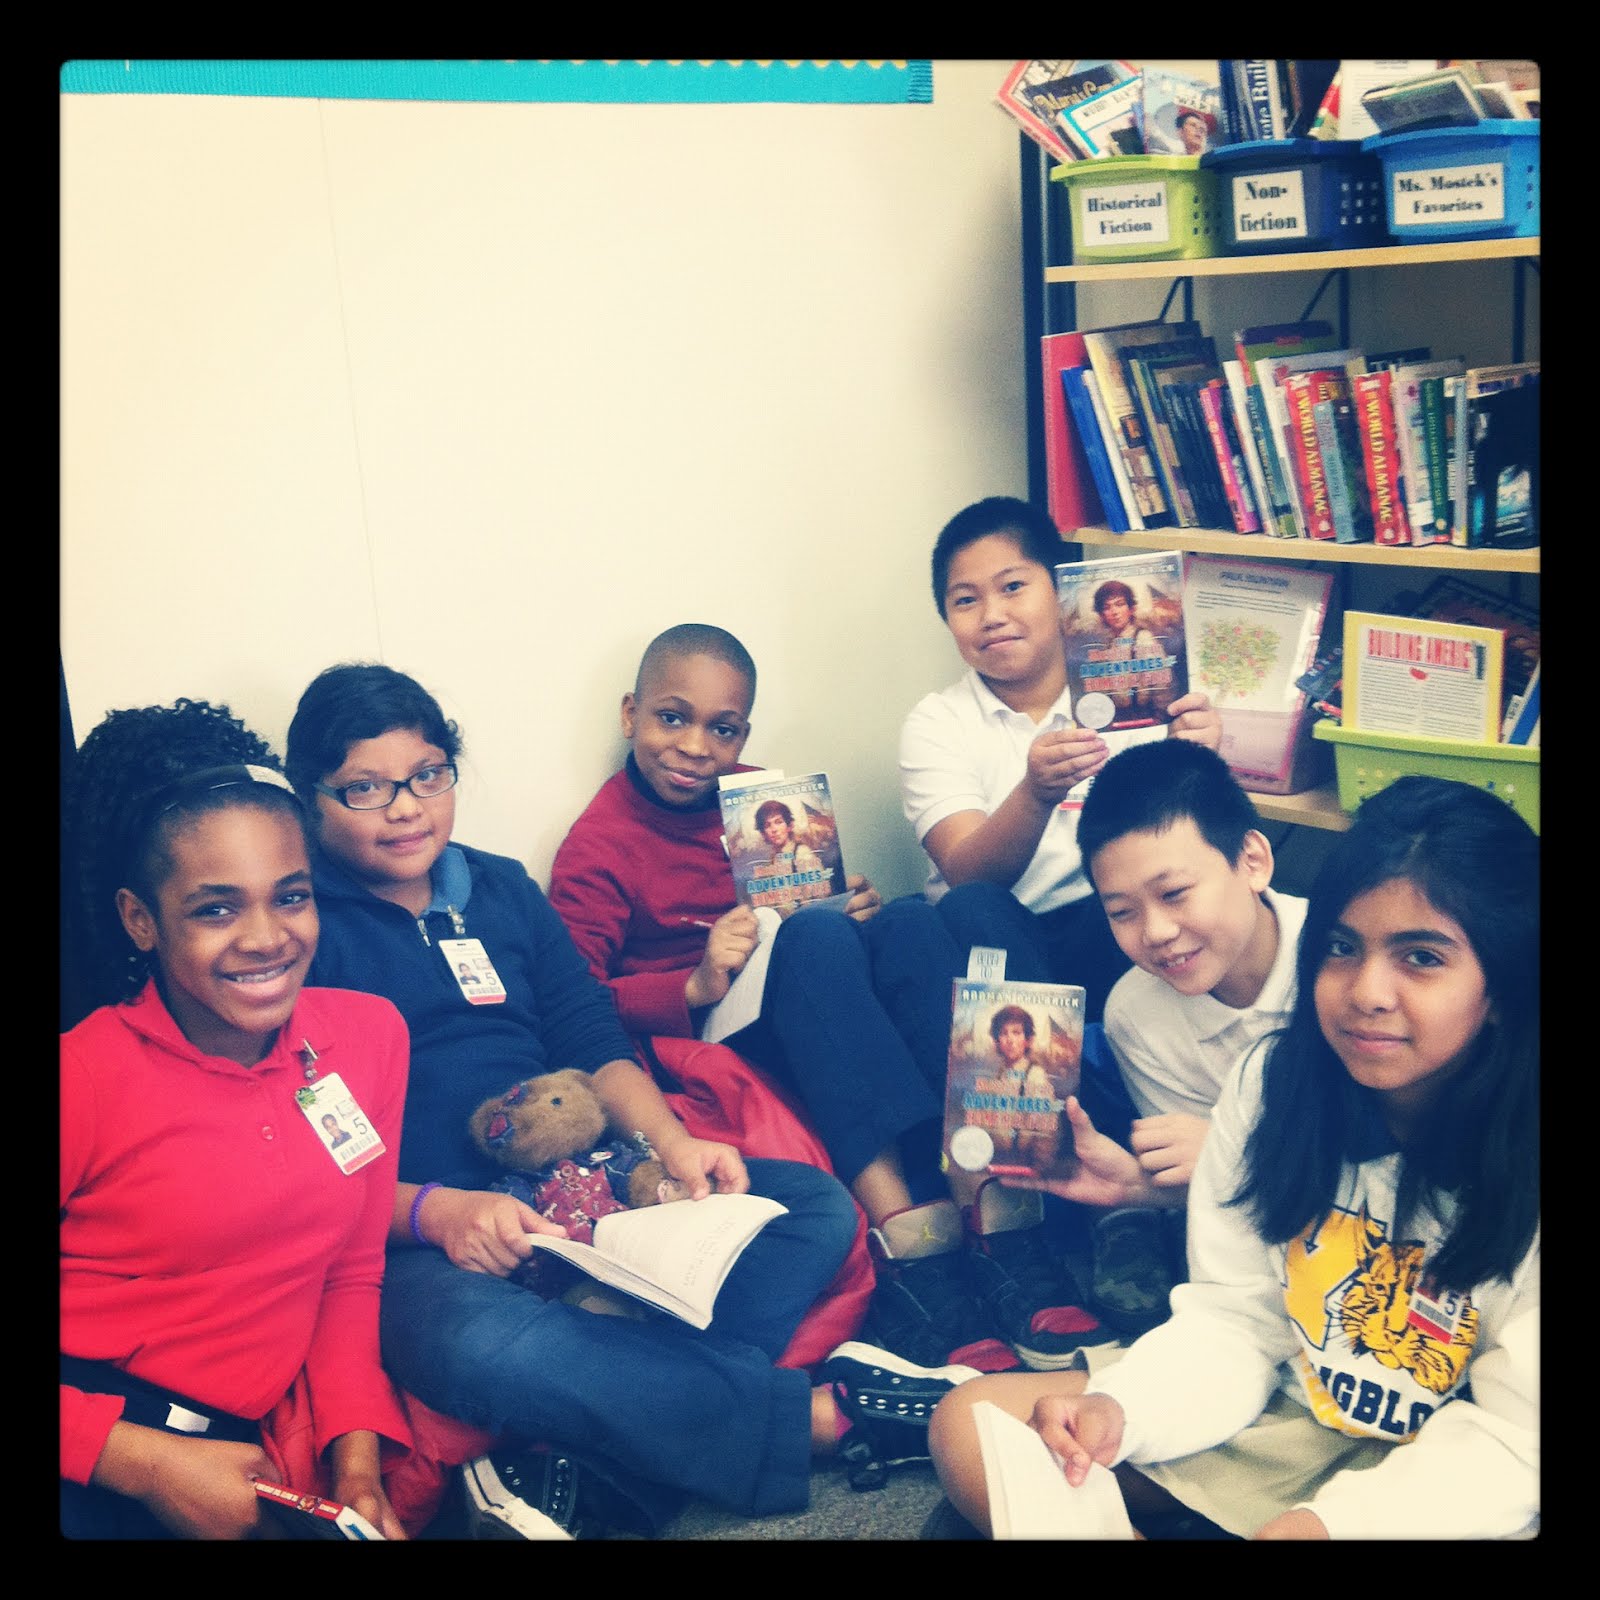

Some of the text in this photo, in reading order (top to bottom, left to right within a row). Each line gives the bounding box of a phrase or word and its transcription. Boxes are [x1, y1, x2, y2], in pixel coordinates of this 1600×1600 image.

[1245, 181, 1288, 200] Non-
[1398, 172, 1498, 192] Ms. Mostek's
[1087, 192, 1163, 213] Historical
[1413, 198, 1484, 214] Favorites
[1099, 220, 1153, 235] Fiction
[1298, 394, 1317, 450] WORLD
[1366, 397, 1393, 524] WORLD ALMANAC
[1306, 453, 1329, 517] ALMANAC
[747, 869, 823, 893] ADVENTURES
[484, 972, 497, 986] 5
[352, 1116, 368, 1135] 5
